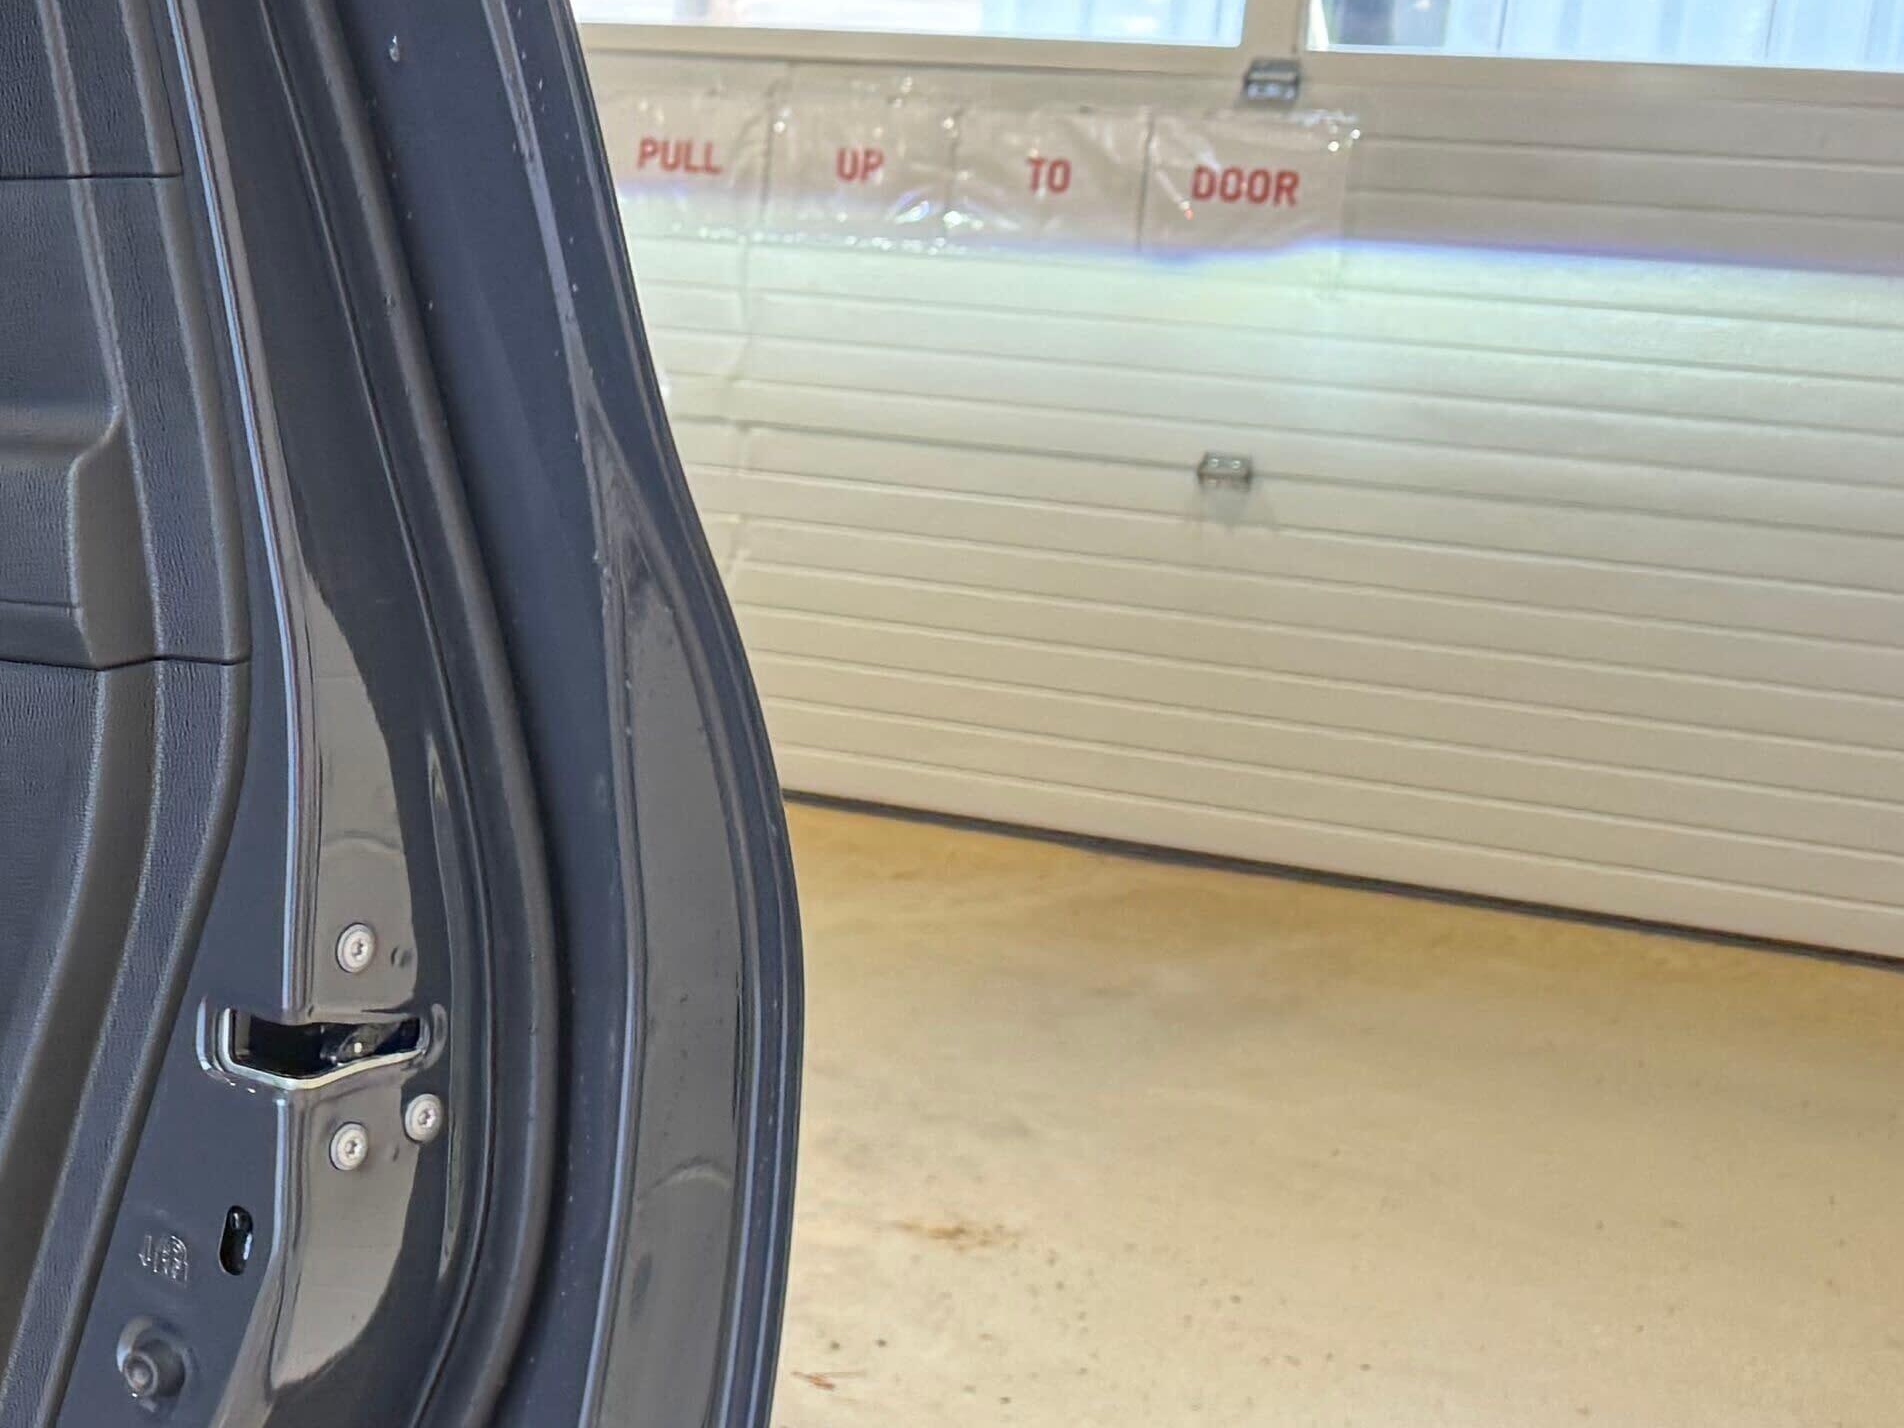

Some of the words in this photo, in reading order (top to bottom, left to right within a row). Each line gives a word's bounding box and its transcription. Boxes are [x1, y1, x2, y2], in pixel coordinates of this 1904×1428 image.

[637, 136, 723, 174] PULL
[835, 148, 884, 182] UP
[1028, 156, 1073, 194] TO
[1191, 166, 1300, 206] DOOR
